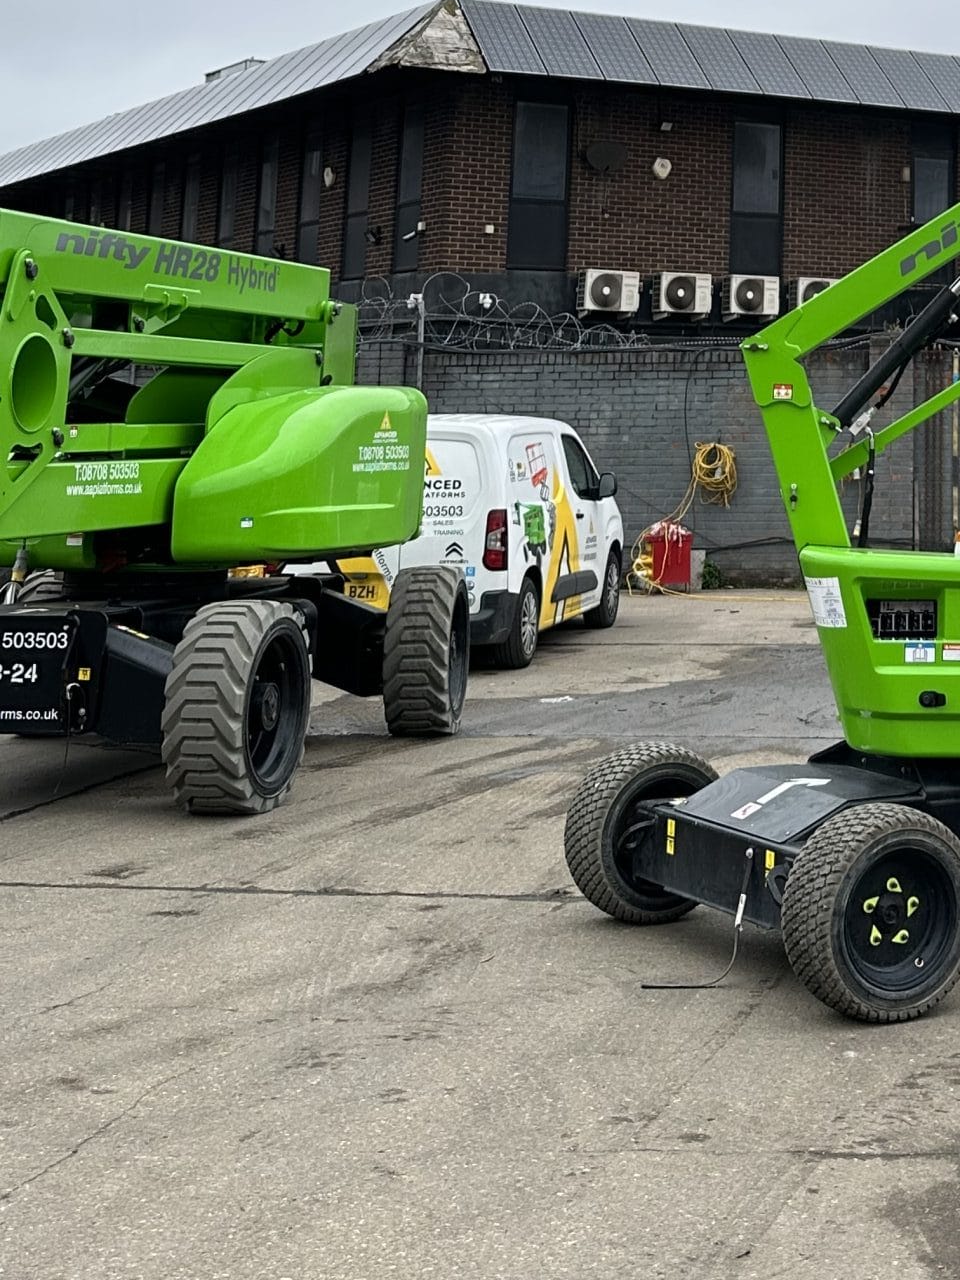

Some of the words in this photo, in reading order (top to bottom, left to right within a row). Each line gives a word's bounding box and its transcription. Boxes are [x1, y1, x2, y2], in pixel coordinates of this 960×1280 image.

[55, 230, 151, 270] nifty
[153, 242, 222, 282] HR28
[74, 463, 108, 482] T:08708
[109, 462, 140, 480] 503503
[349, 585, 376, 599] BZH
[1, 631, 69, 649] 503503
[0, 663, 39, 684] -24
